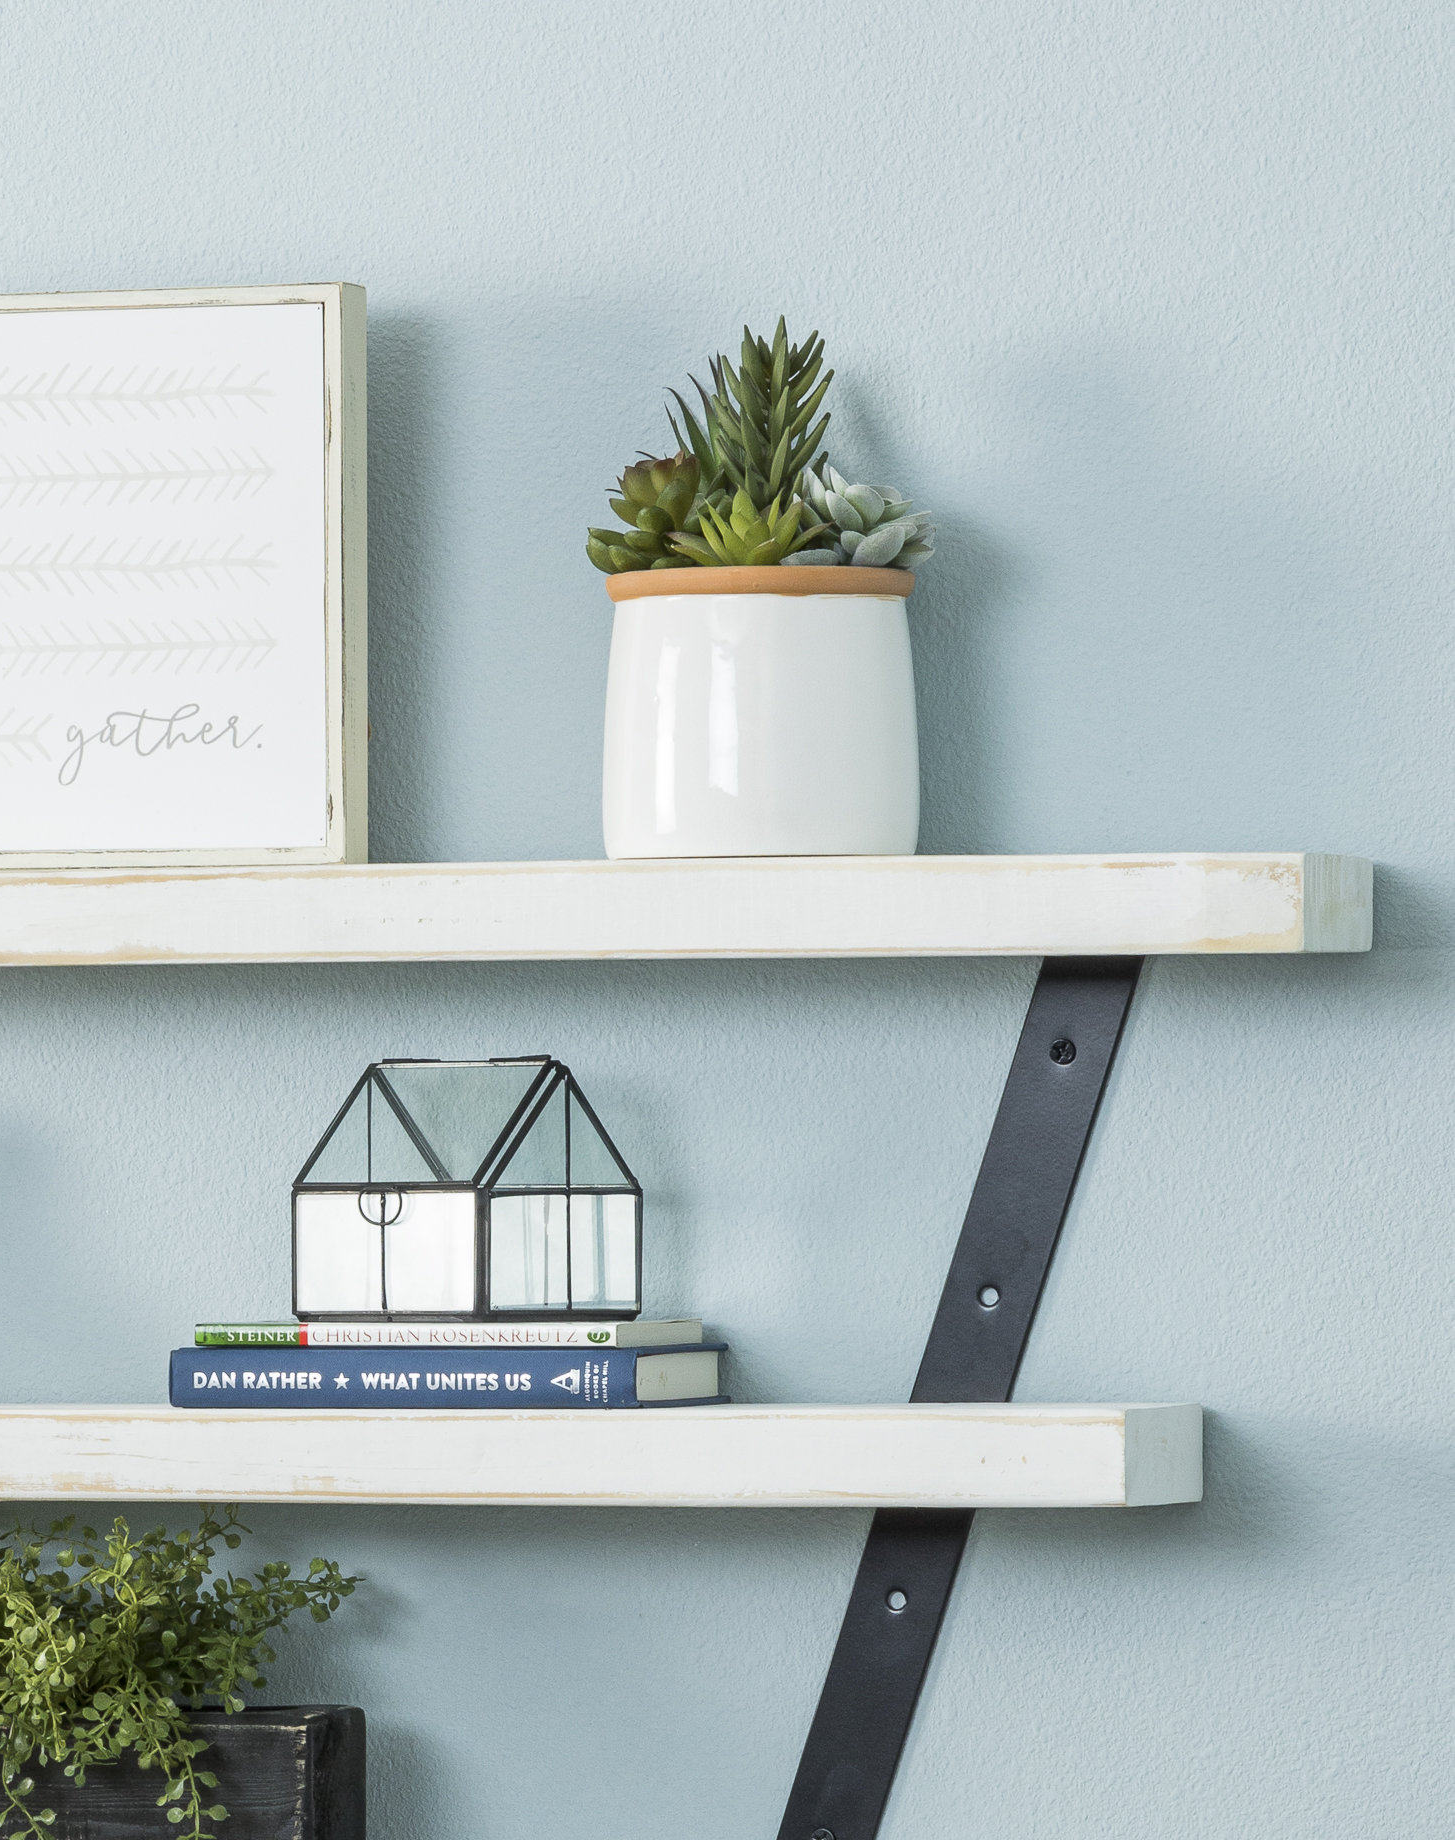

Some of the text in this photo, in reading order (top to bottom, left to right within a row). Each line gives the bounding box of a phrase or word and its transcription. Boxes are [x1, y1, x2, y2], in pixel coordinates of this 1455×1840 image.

[58, 703, 264, 786] gather.
[227, 1330, 296, 1342] STEINER
[312, 1329, 579, 1343] CHRISTIAN ROSENKREUTZ
[593, 1364, 599, 1374] OF
[193, 1372, 322, 1390] DAN RATHER
[362, 1372, 532, 1391] WHAT UNITES US
[601, 1376, 609, 1403] CHAPEL
